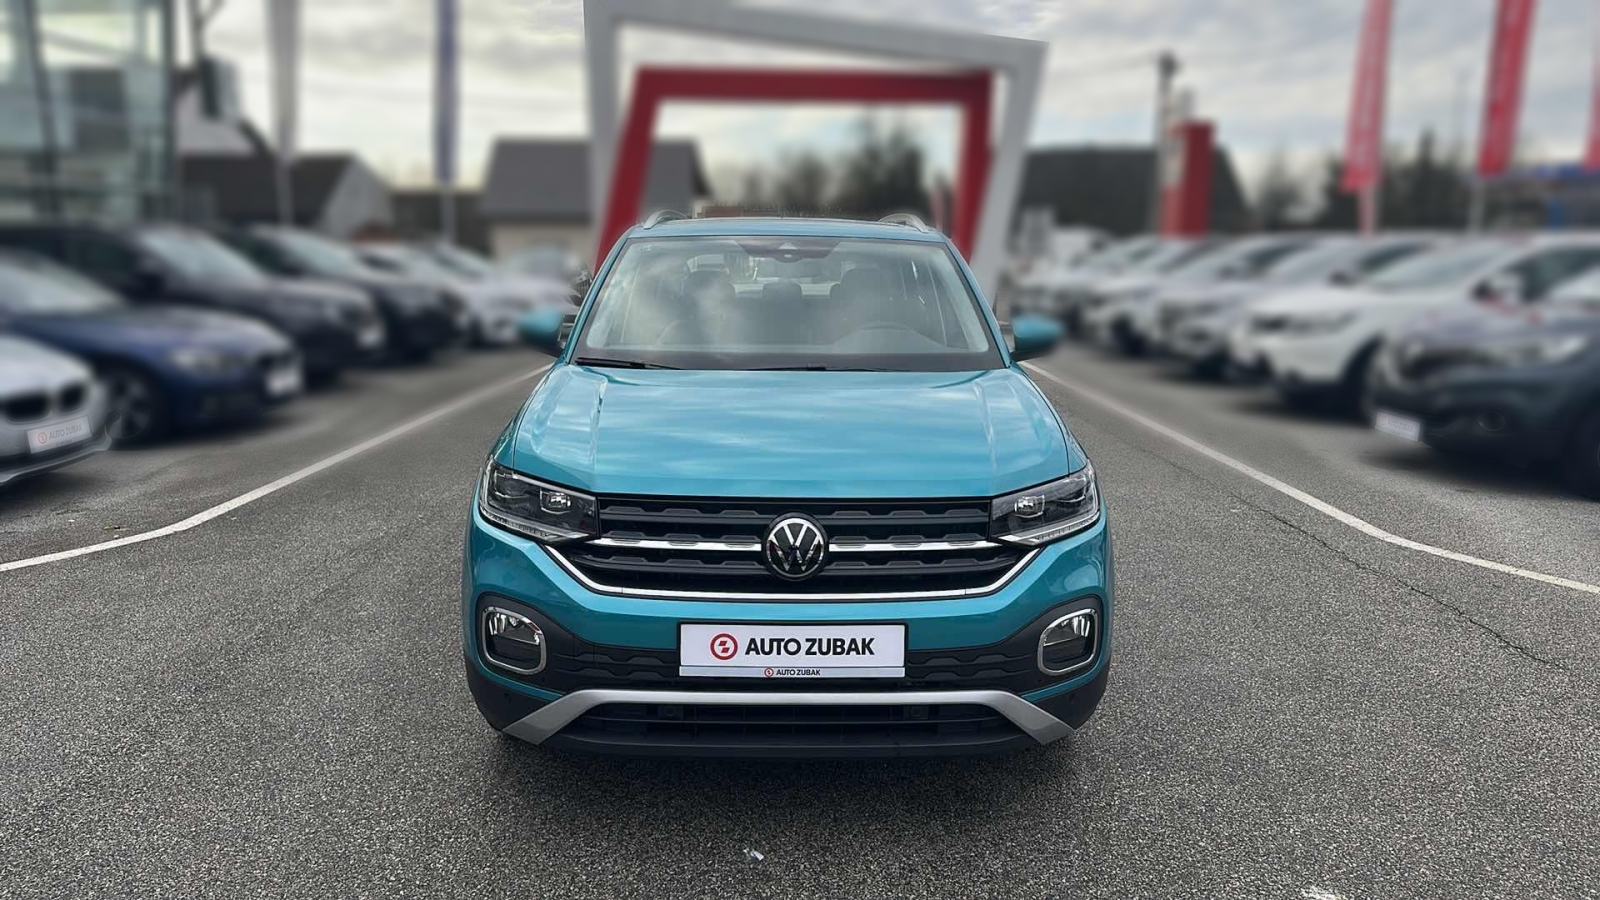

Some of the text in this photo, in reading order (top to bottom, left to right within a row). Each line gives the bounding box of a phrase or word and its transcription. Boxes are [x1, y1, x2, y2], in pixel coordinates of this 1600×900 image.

[768, 519, 823, 575] VW
[745, 638, 875, 655] AUTO ZUBAK
